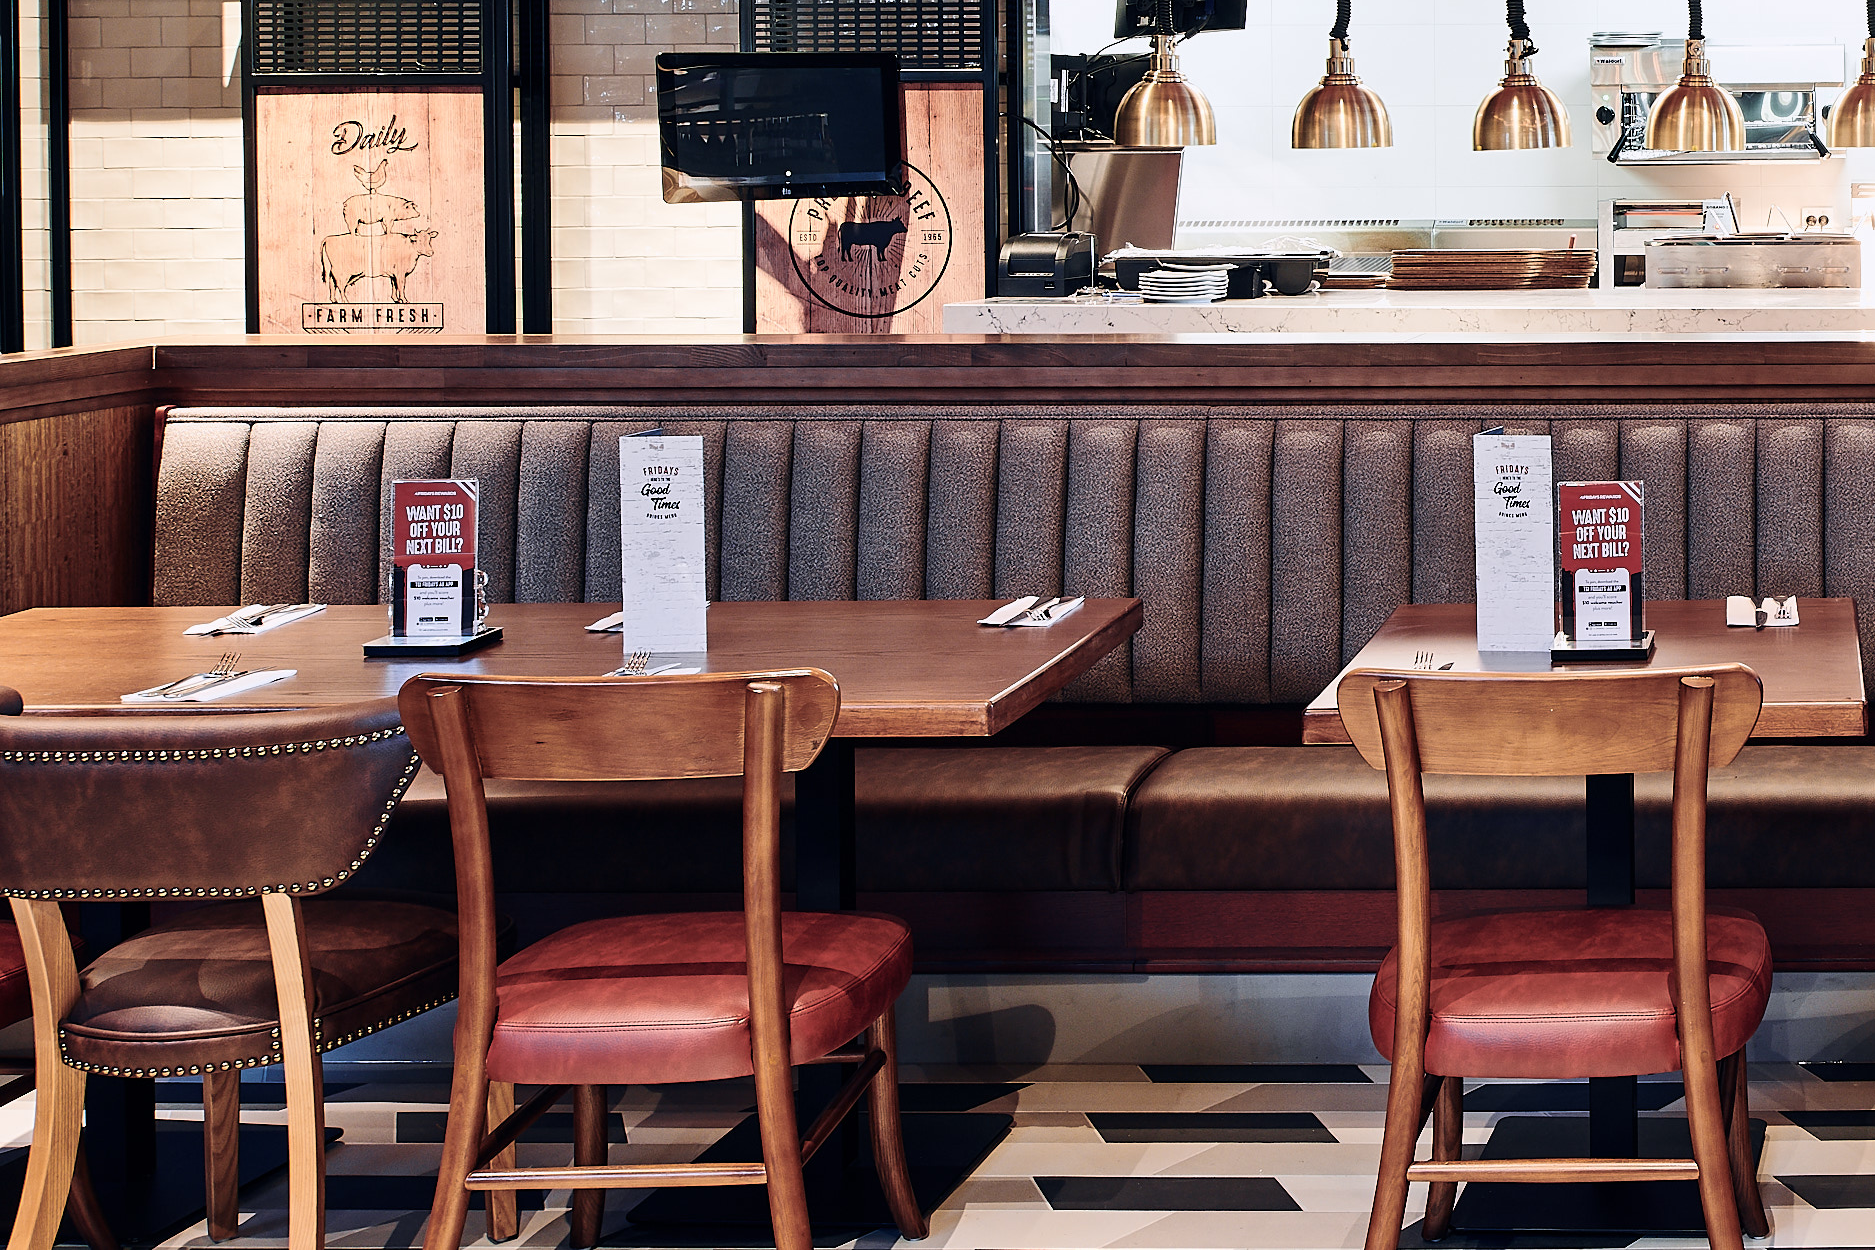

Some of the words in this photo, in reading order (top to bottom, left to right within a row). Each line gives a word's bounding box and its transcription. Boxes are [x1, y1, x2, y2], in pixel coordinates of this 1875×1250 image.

[331, 115, 419, 155] Daily
[923, 233, 942, 241] 1965
[814, 254, 829, 272] TOP
[829, 275, 873, 298] QUALITY
[880, 279, 908, 297] MEAT
[909, 253, 929, 278] CUTS
[316, 309, 363, 323] FARM
[376, 309, 429, 323] FRESH
[643, 466, 679, 476] FRIDAYS
[1495, 465, 1529, 475] FRIDAYS
[641, 483, 671, 497] Good
[1494, 482, 1521, 495] Good
[651, 497, 680, 510] Times
[1503, 496, 1530, 509] Times
[406, 504, 441, 521] WANT
[443, 503, 464, 521] $10
[1572, 508, 1606, 525] WANT
[1609, 507, 1629, 524] $10
[410, 522, 429, 538] OFF
[431, 521, 460, 537] YOUR
[1576, 526, 1595, 542] OFF
[1597, 525, 1627, 540] YOUR
[406, 539, 433, 555] NEXT
[435, 538, 464, 553] BILL?
[1573, 543, 1599, 559] NEXT
[1601, 541, 1629, 557] BILL?
